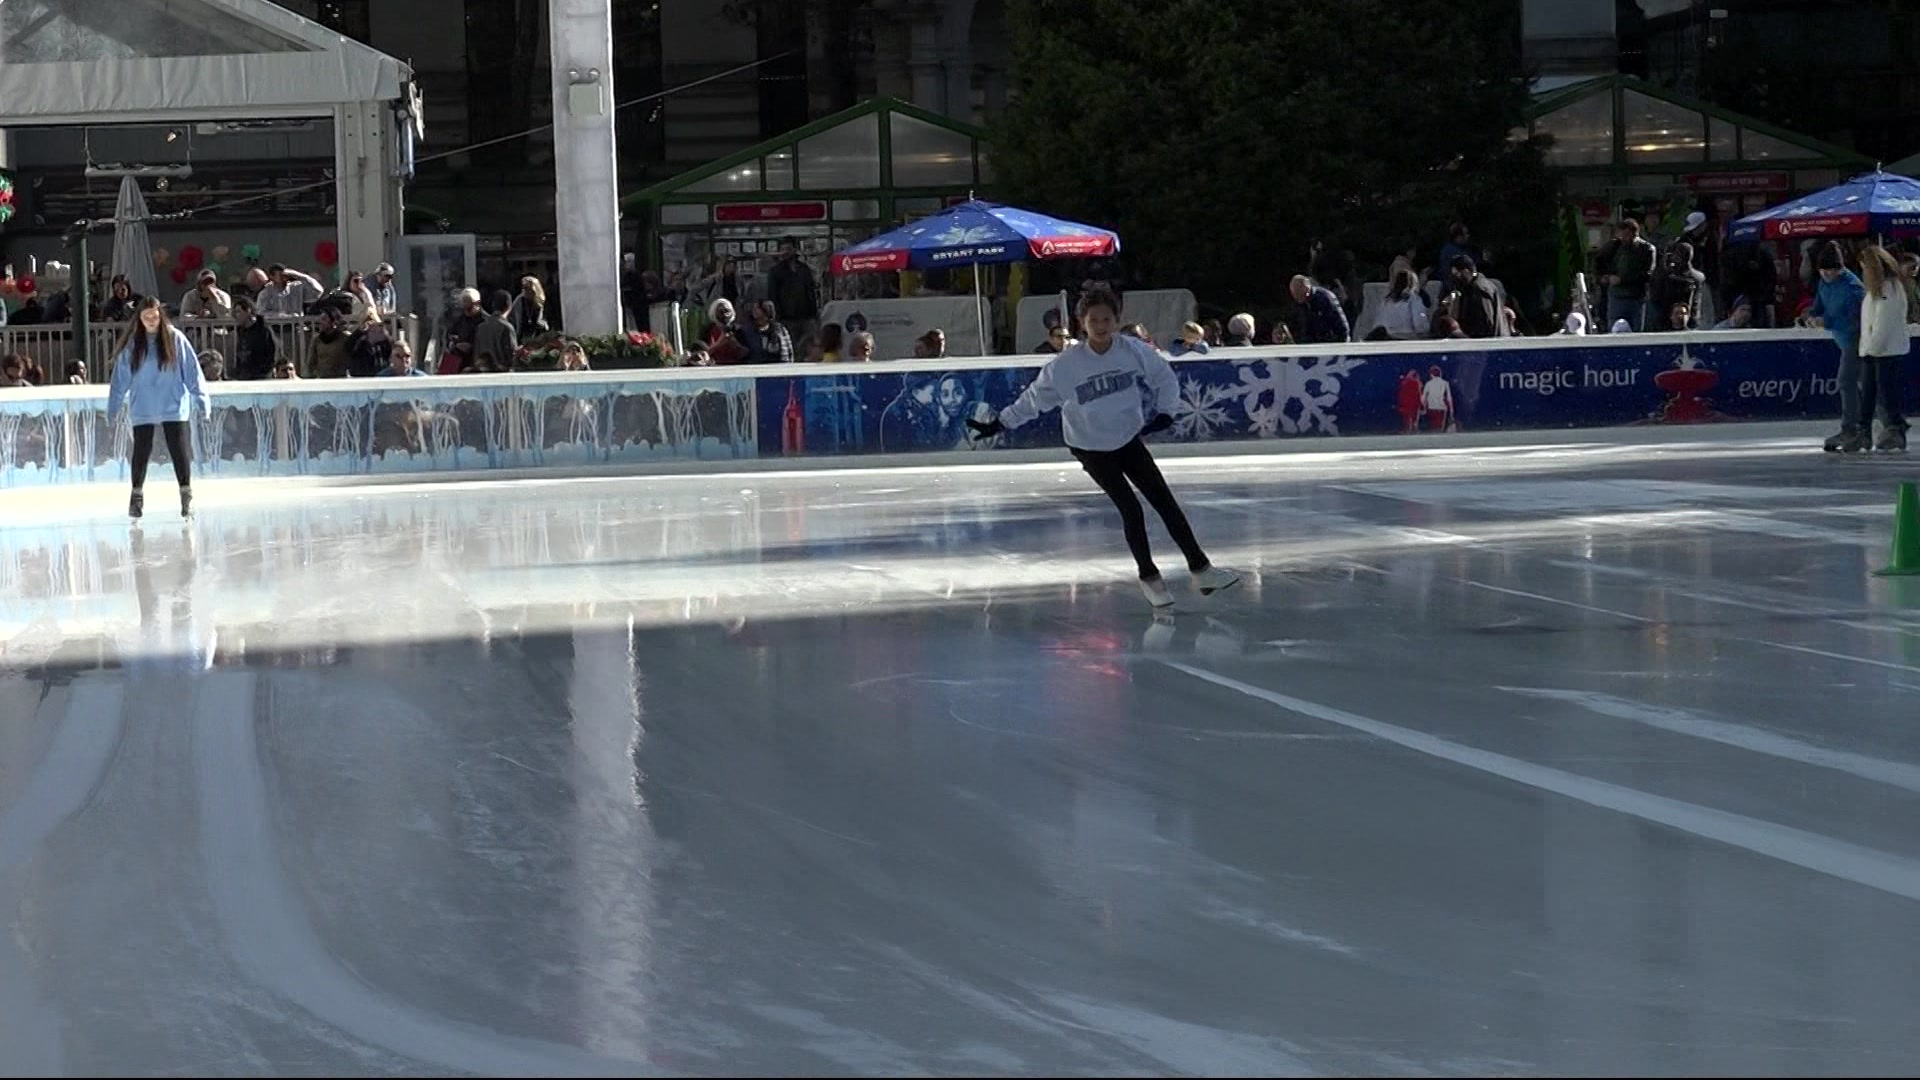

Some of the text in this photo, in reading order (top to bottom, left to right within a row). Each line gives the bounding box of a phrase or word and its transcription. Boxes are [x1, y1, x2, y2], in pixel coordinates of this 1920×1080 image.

[933, 247, 1005, 260] BRYANT PARK
[1499, 363, 1641, 396] magic hour
[1739, 372, 1842, 403] every ho
